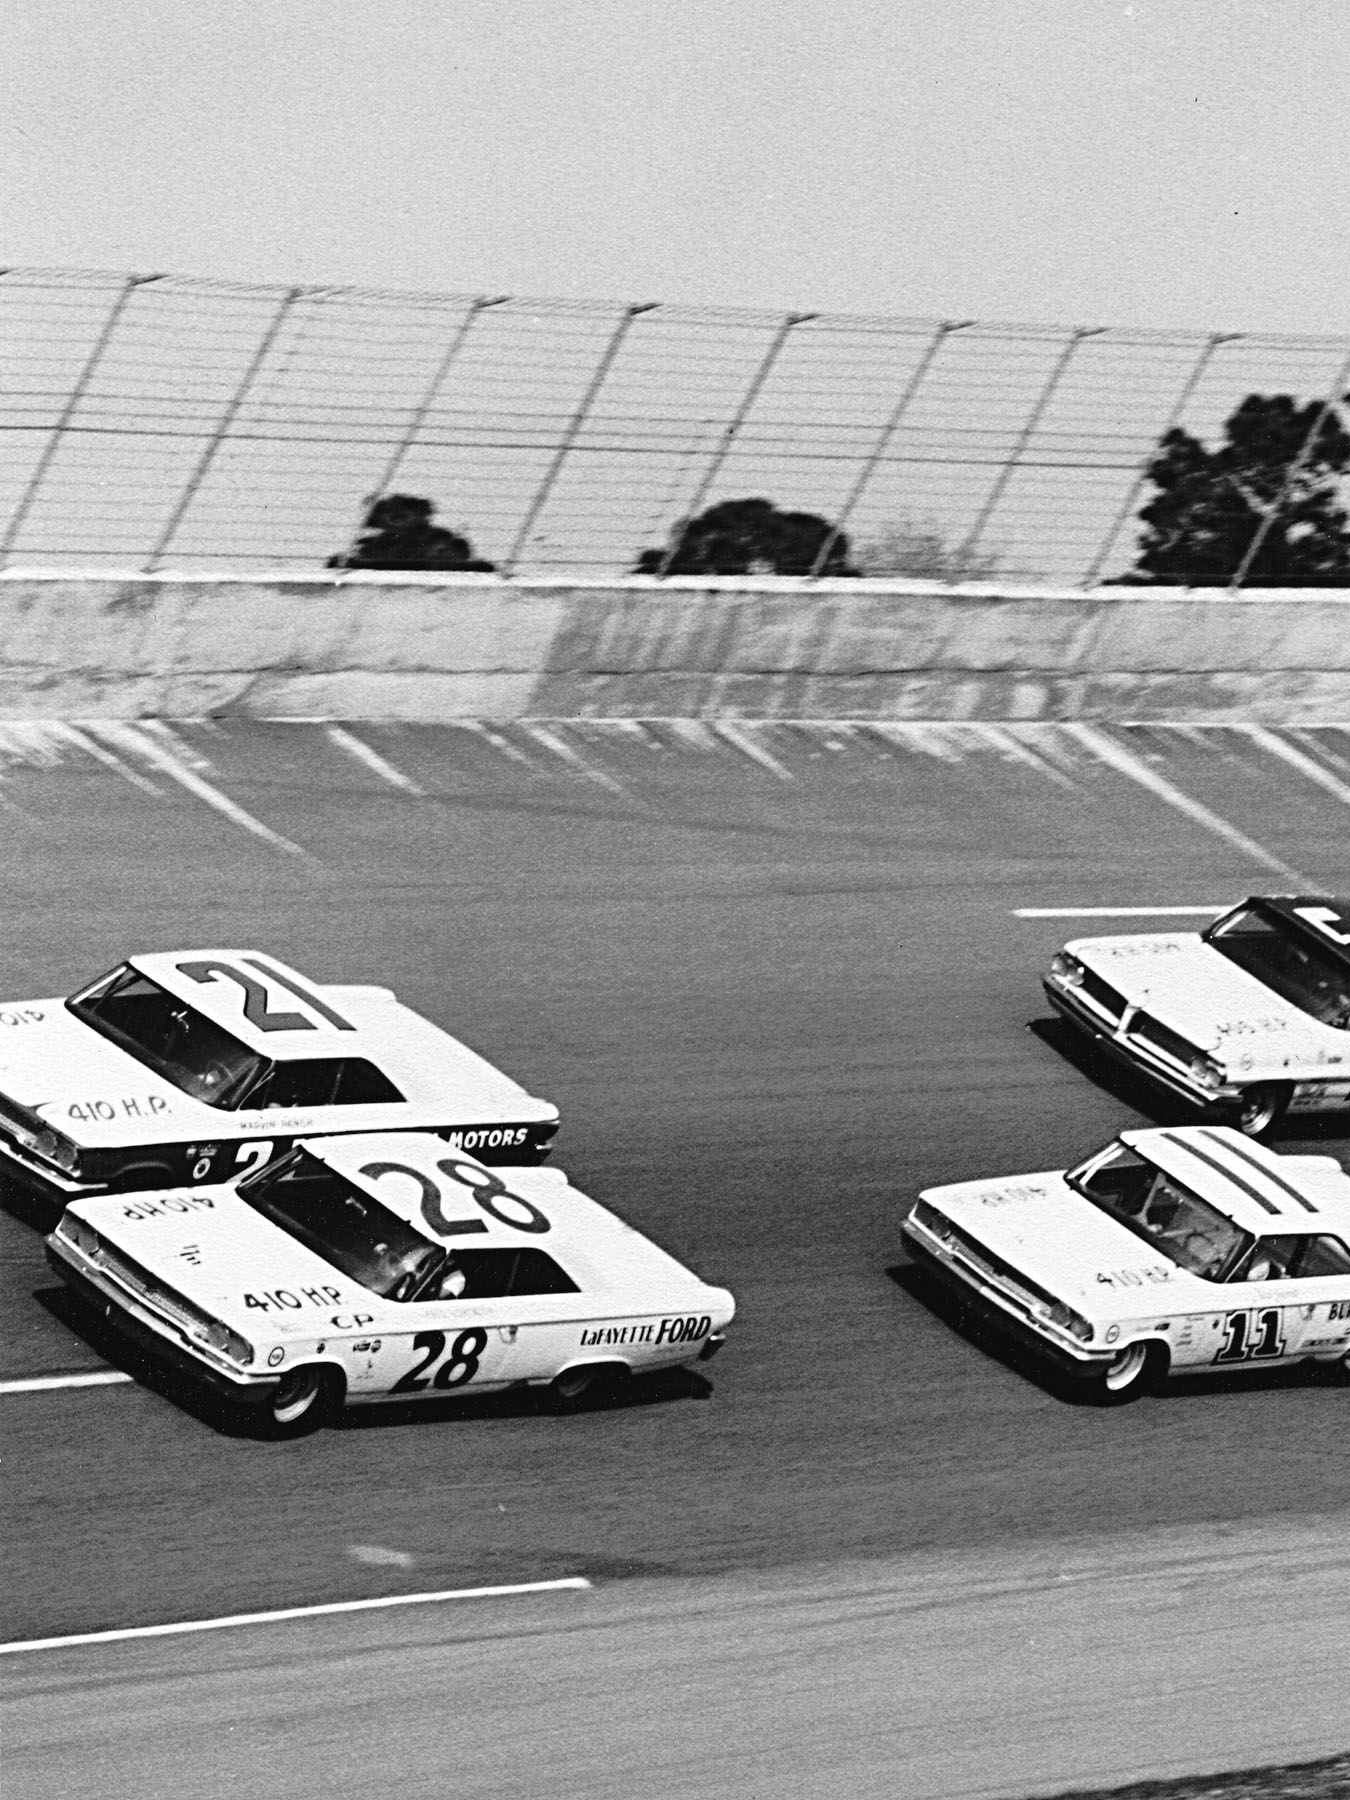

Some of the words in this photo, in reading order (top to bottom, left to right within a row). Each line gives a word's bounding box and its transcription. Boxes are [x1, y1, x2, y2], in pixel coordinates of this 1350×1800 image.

[175, 958, 357, 1032] 21
[68, 1101, 115, 1121] 410
[448, 1128, 528, 1149] MOTORS
[358, 1158, 551, 1237] 28
[244, 1290, 302, 1312] 410
[655, 1316, 712, 1345] FORD
[1210, 1305, 1287, 1366] 11
[388, 1326, 488, 1394] 28
